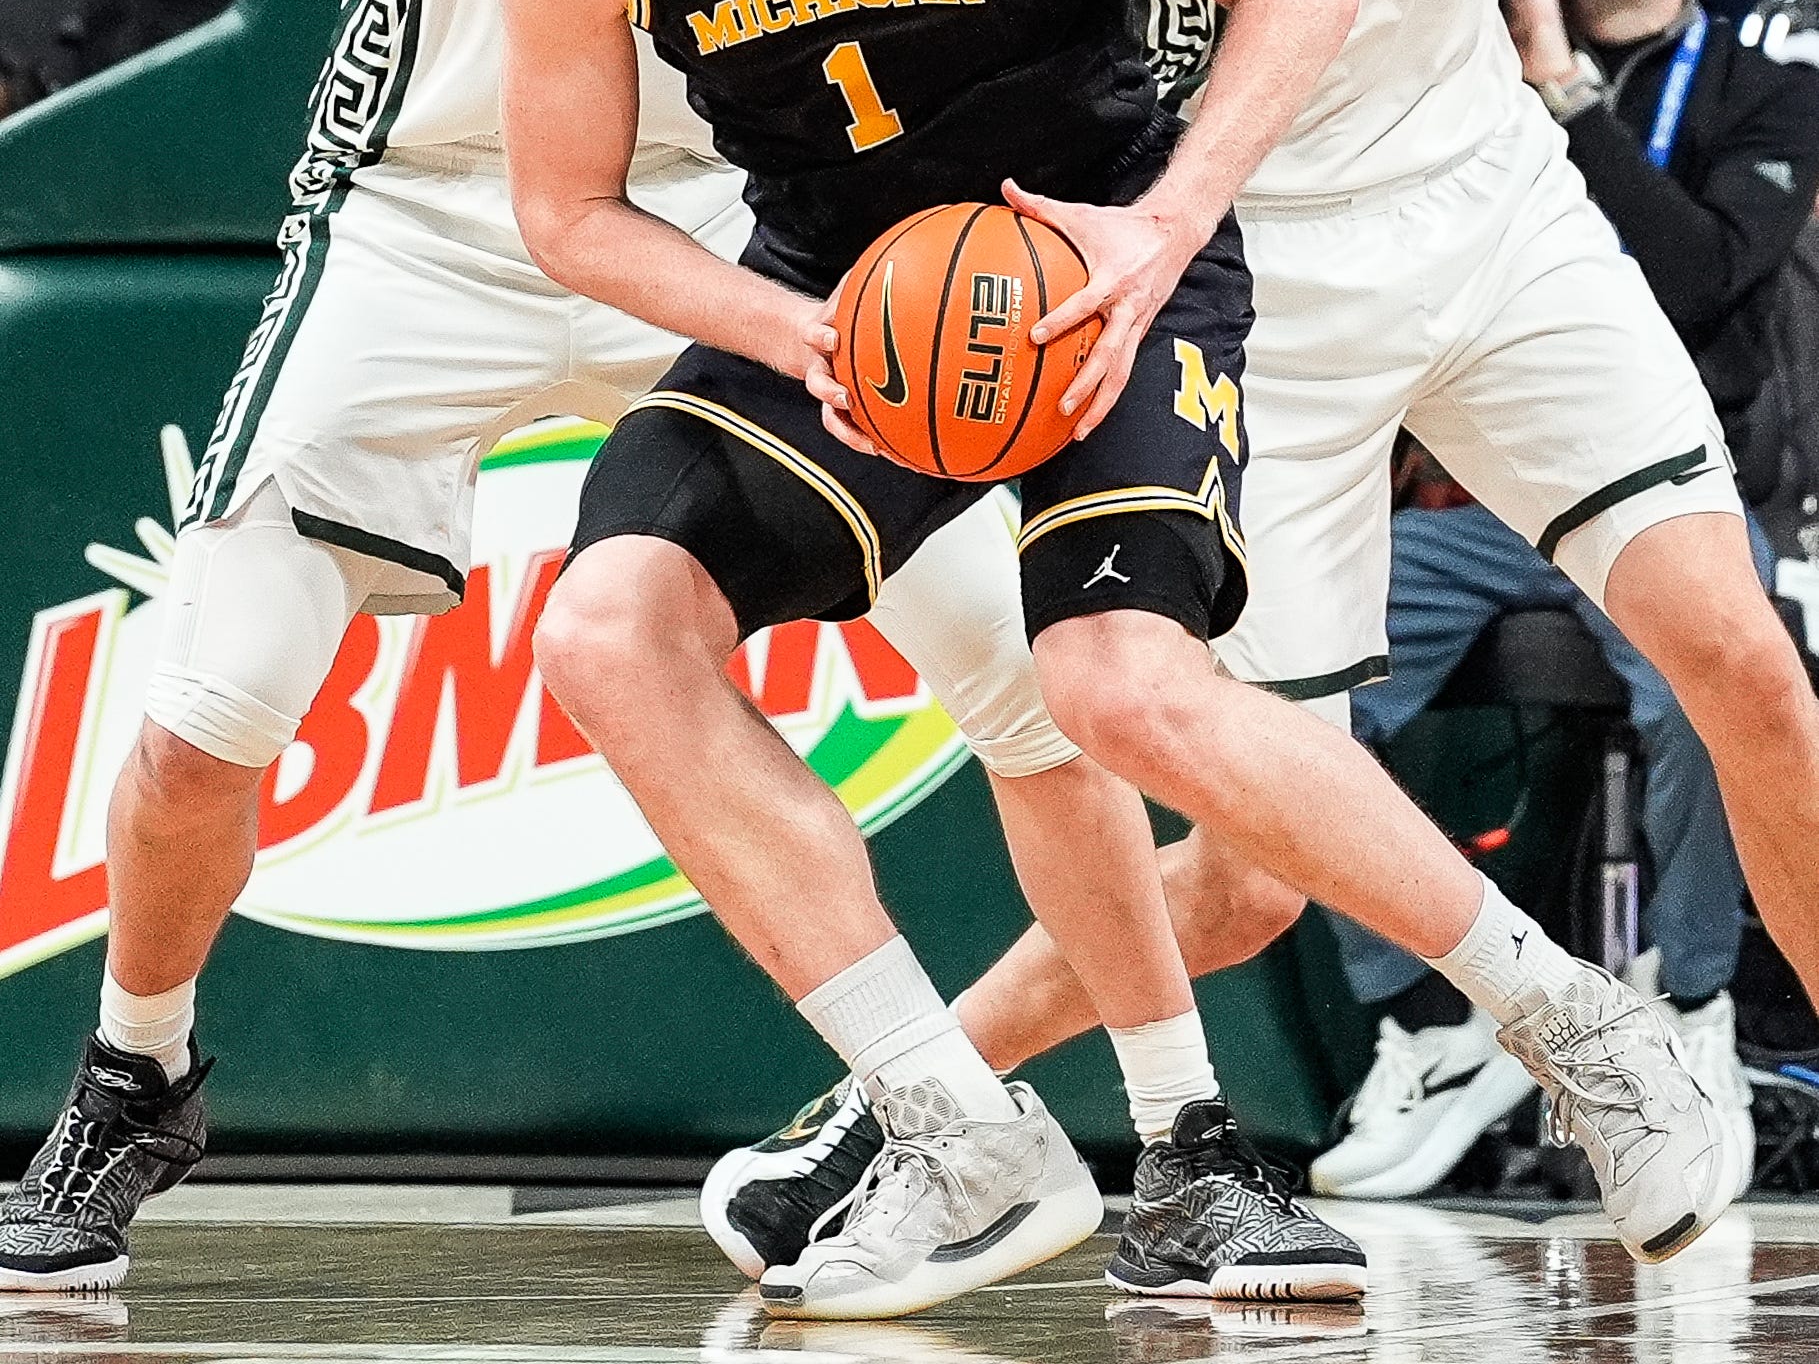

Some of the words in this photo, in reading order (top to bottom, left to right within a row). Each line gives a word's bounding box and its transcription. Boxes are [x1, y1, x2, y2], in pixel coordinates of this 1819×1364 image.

[821, 41, 904, 153] 1
[953, 272, 1012, 423] ELITE
[995, 277, 1024, 425] CHAMPIONSHIP
[1173, 337, 1240, 466] M
